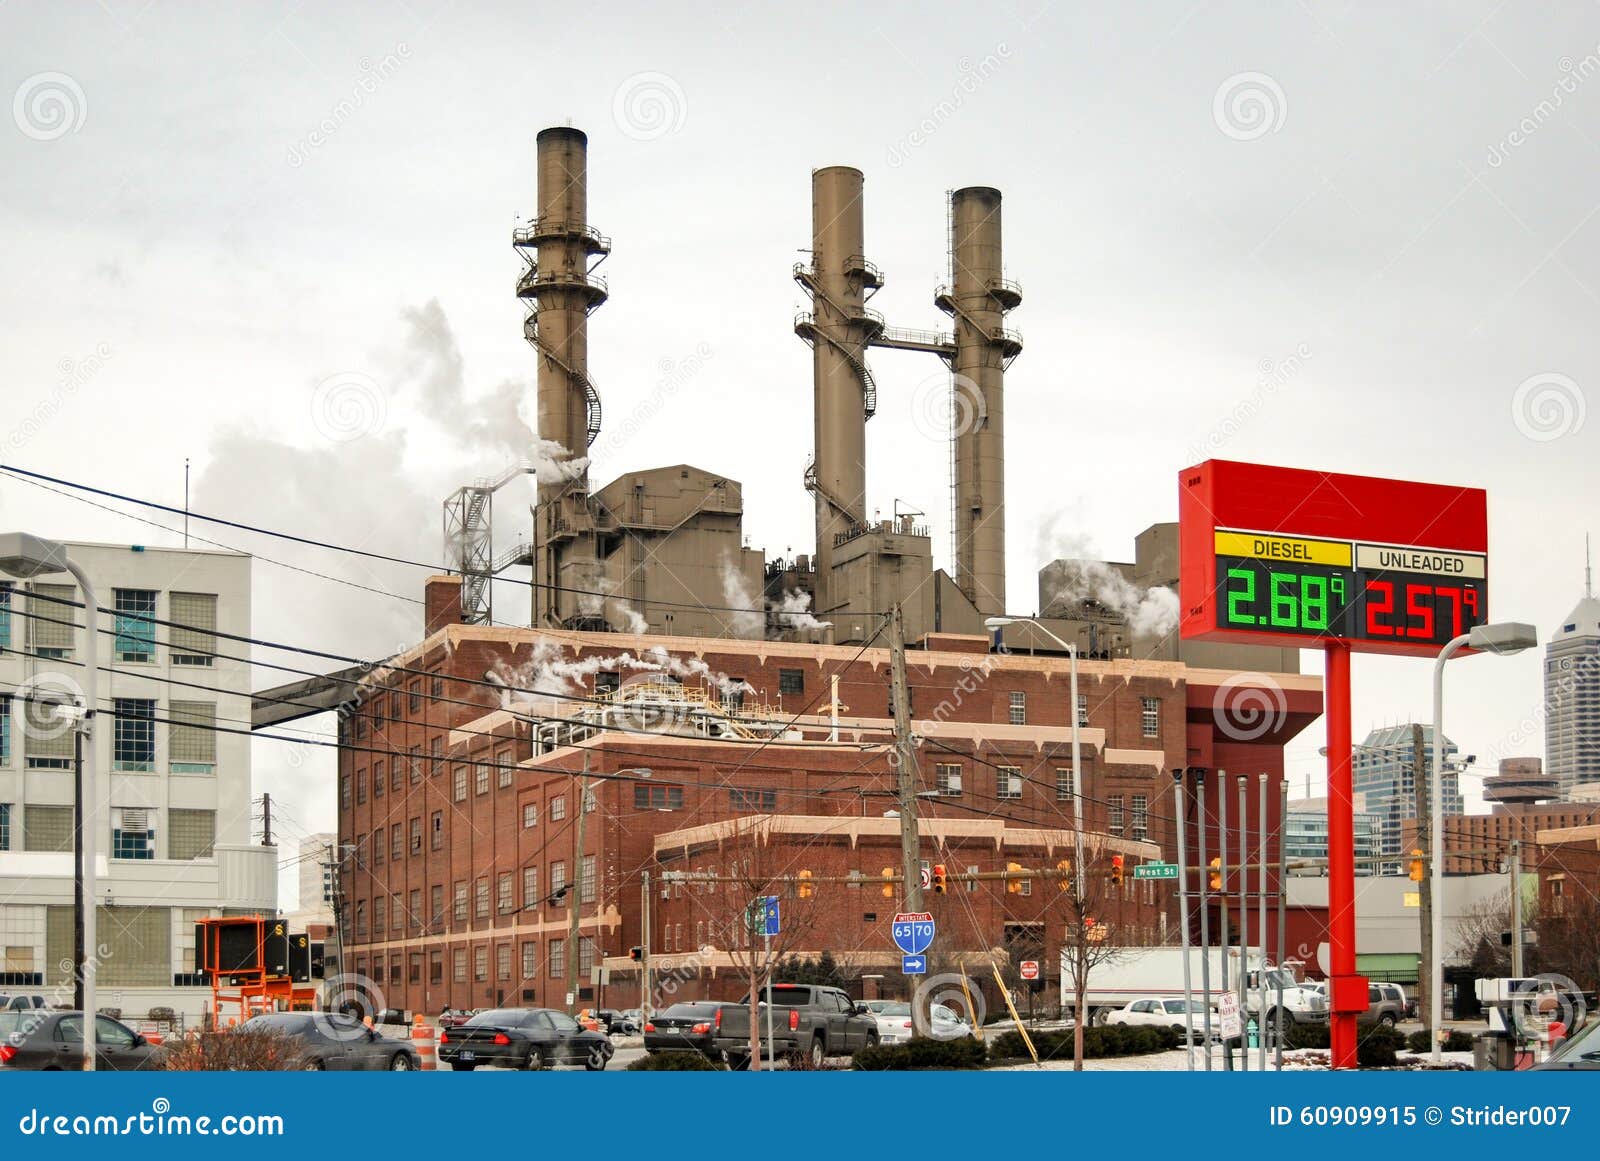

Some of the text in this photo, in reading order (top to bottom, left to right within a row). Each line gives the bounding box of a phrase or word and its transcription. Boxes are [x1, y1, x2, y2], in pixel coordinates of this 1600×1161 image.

[1254, 539, 1313, 560] DIESEL
[1379, 551, 1465, 574] UNLEADED
[1139, 867, 1174, 876] West St
[895, 925, 932, 937] 65 70
[1223, 996, 1233, 1005] NO
